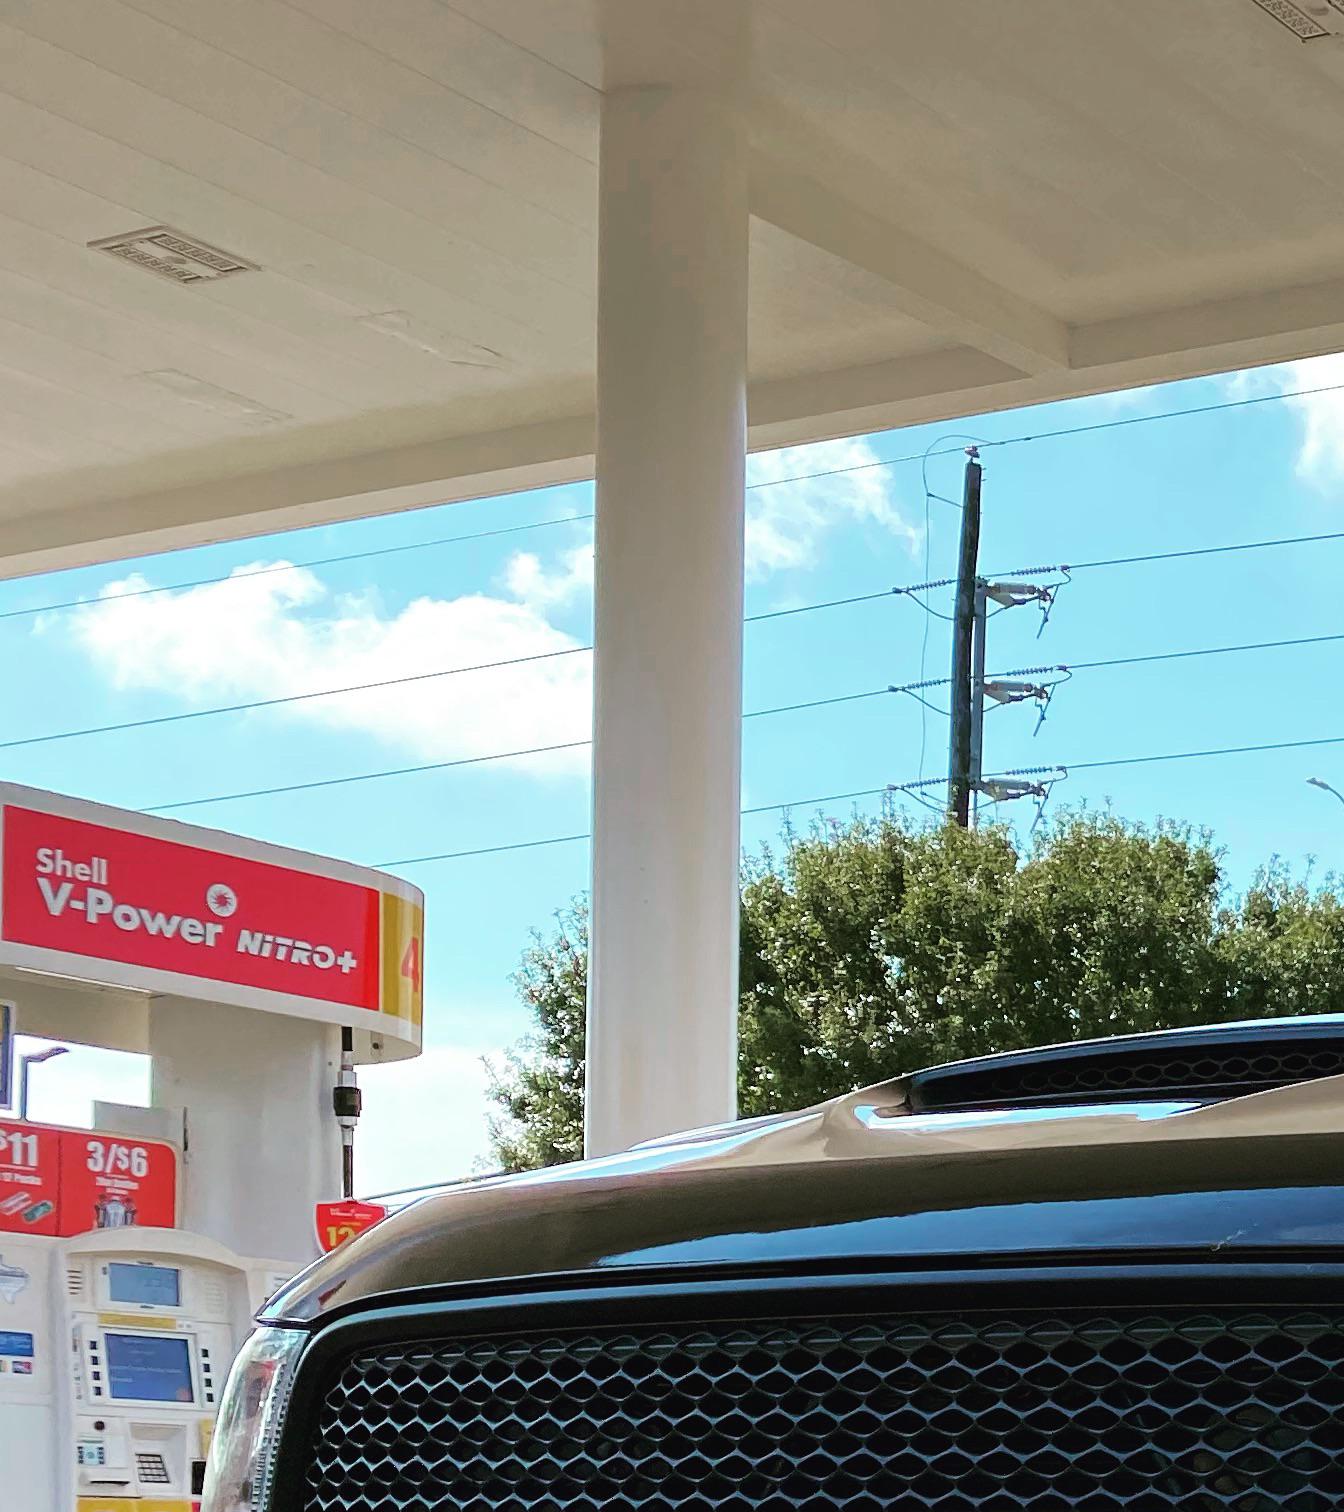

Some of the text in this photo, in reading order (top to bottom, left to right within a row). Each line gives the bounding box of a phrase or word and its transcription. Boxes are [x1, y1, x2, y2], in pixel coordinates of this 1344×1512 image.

[36, 847, 108, 885] Shell
[36, 876, 224, 947] V-Power
[401, 936, 419, 992] 4
[86, 1141, 149, 1177] 3/$6
